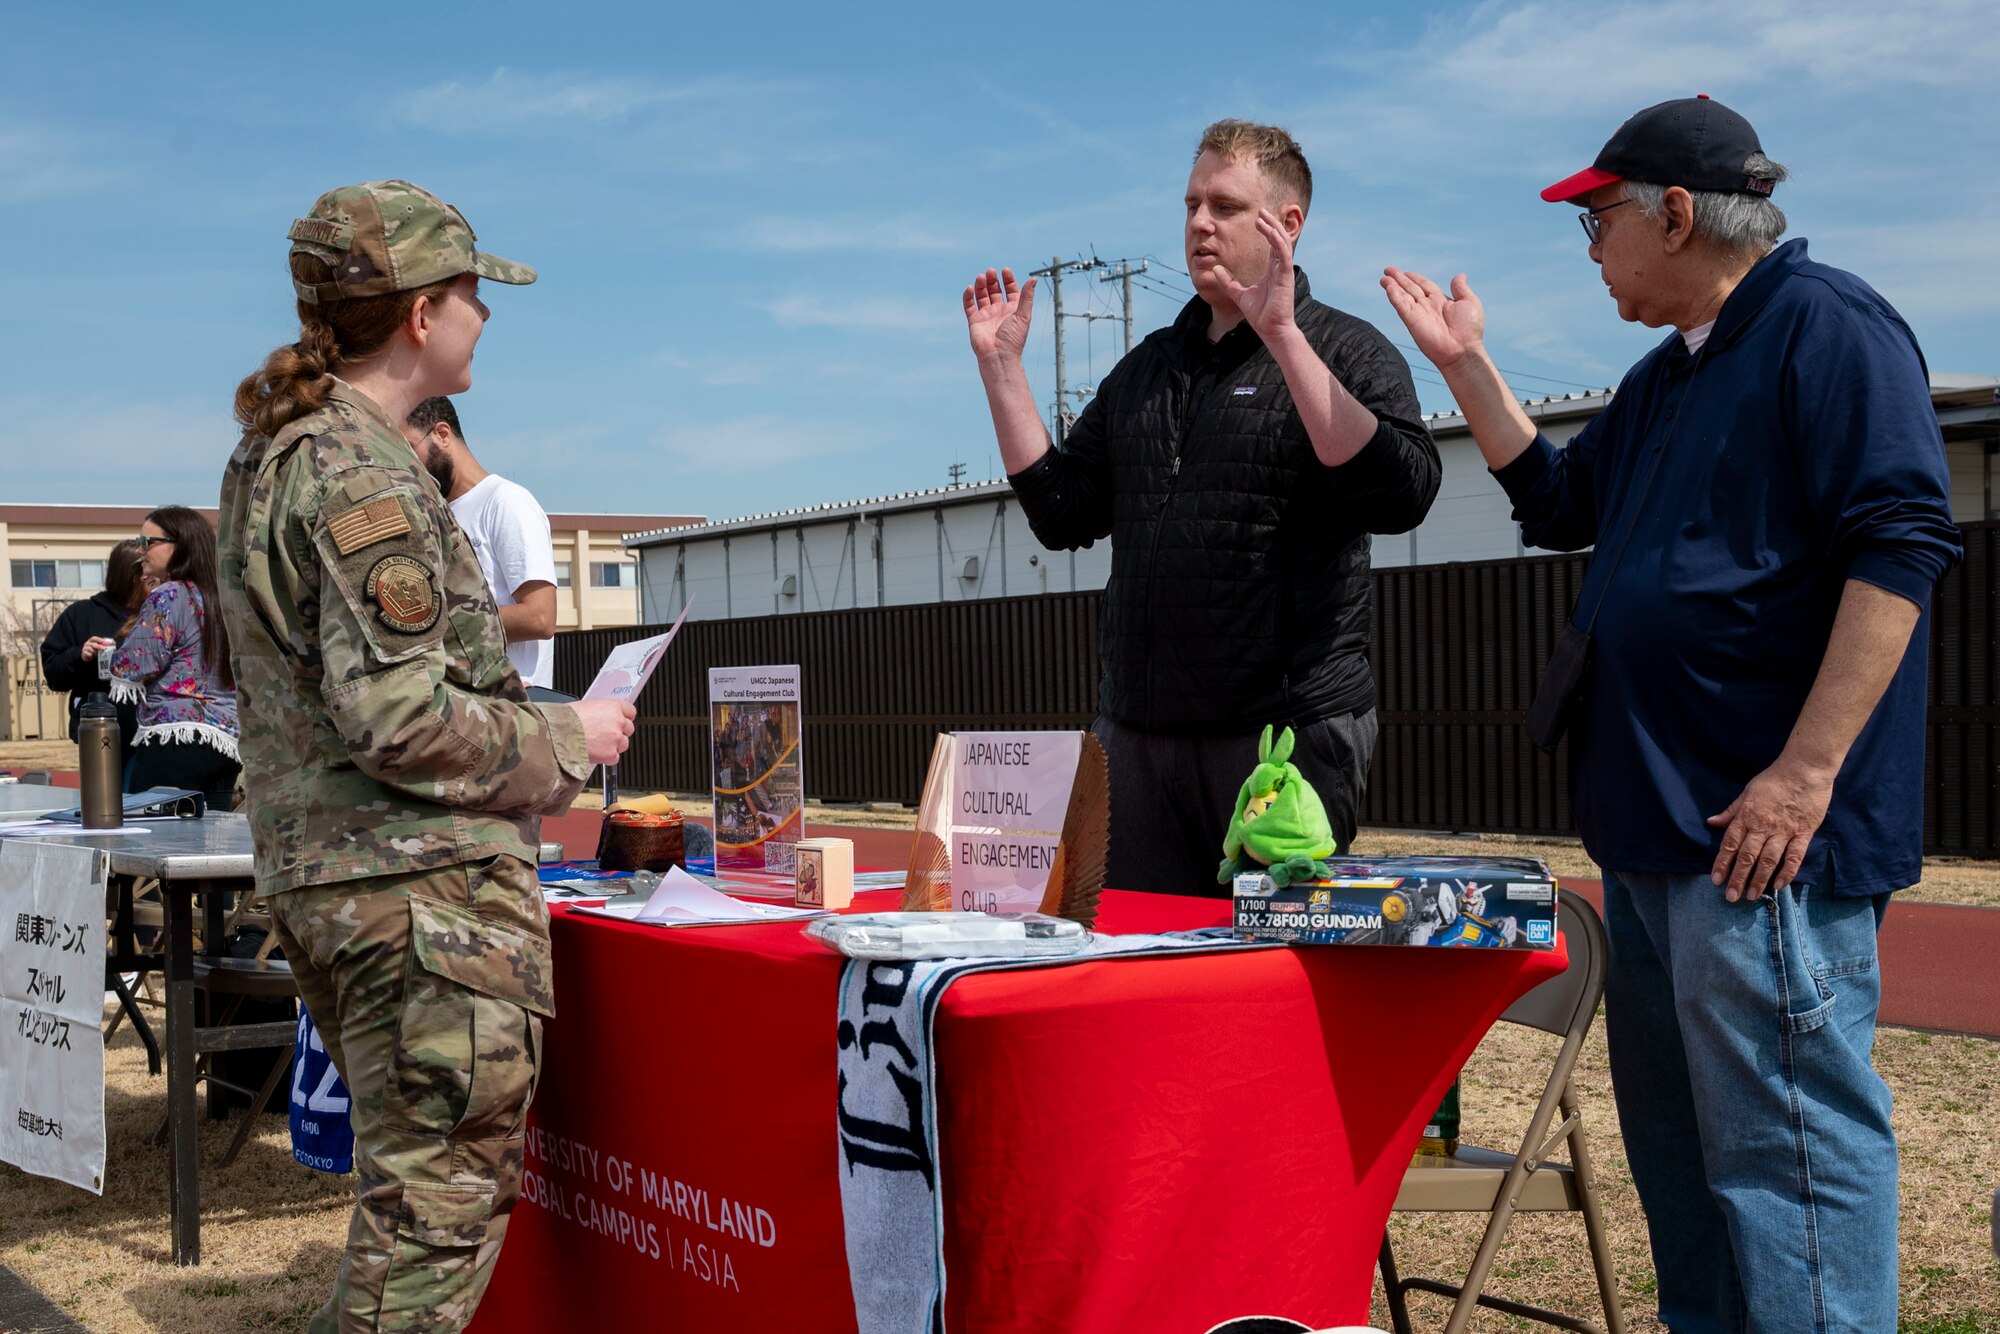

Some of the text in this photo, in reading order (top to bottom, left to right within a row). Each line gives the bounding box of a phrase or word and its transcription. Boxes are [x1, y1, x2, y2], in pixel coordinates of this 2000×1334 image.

[750, 677, 795, 686] UMGC Japanese
[723, 689, 796, 699] Cultural Engagement Club
[963, 742, 1031, 766] JAPANESE
[962, 791, 1032, 816] CULTURAL
[961, 890, 997, 912] CLUB
[1240, 899, 1266, 911] 1/100
[1238, 913, 1383, 929] RX-78F00 GUNDAM
[525, 1126, 776, 1248] VERSITY OF MARYLAND
[520, 1170, 740, 1293] OBAL CAMPUS ASIA
